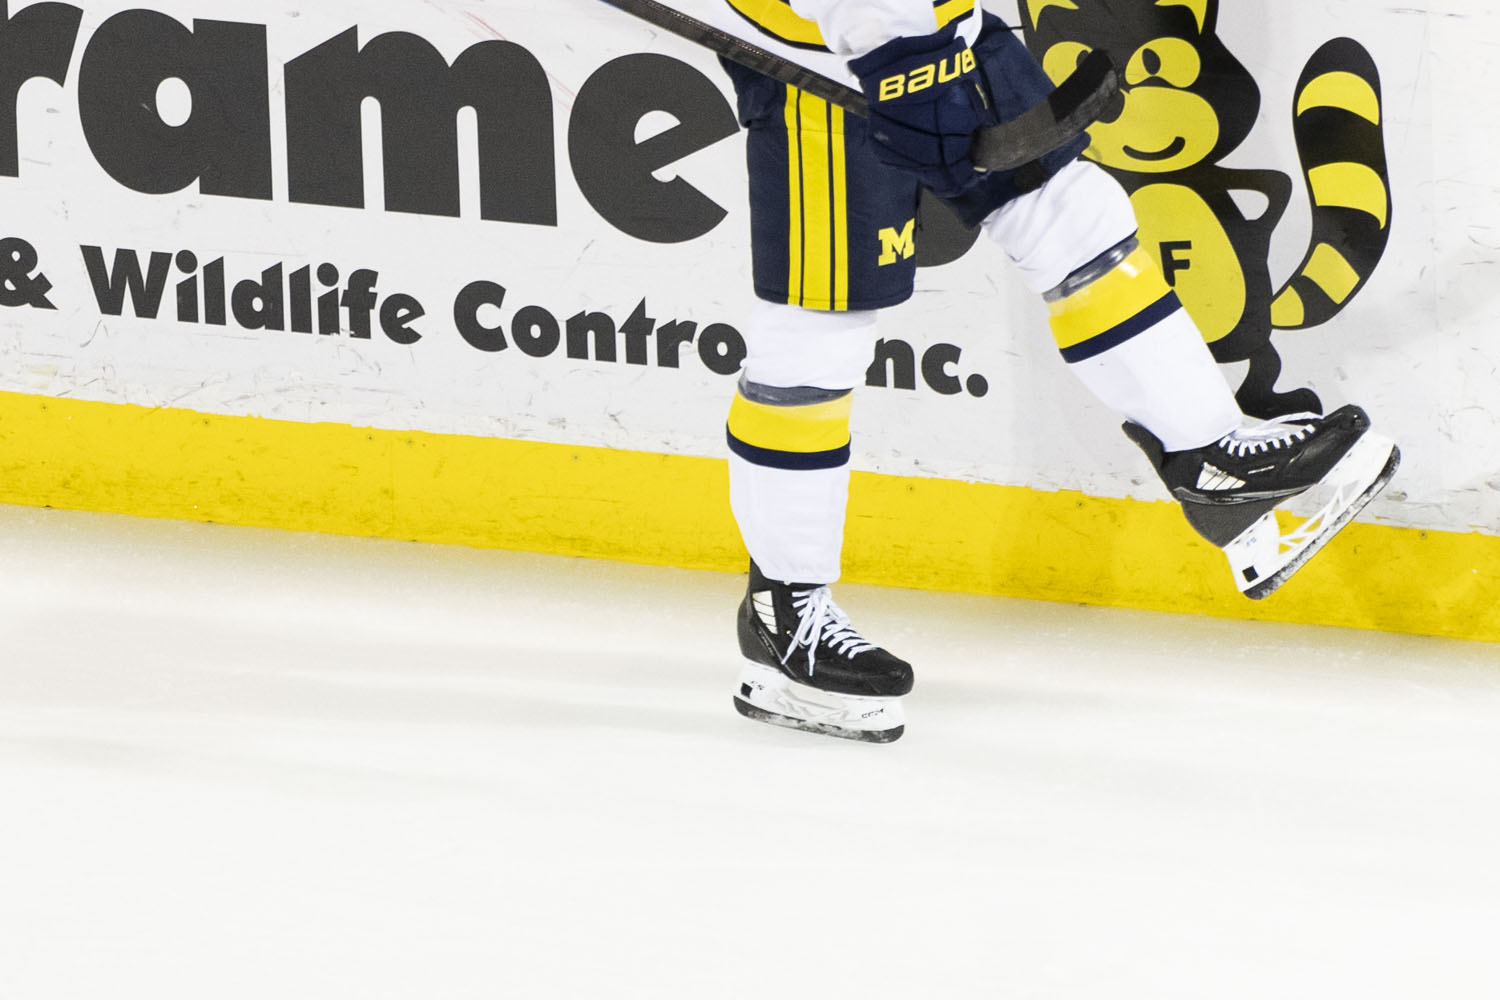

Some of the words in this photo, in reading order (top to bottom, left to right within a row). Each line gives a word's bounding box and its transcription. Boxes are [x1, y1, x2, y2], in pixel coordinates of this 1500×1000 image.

[878, 218, 916, 267] M
[1159, 239, 1192, 288] F
[0, 237, 57, 311] &
[80, 244, 426, 345] Wildlife
[454, 280, 748, 376] Contro
[865, 337, 989, 398] nc.
